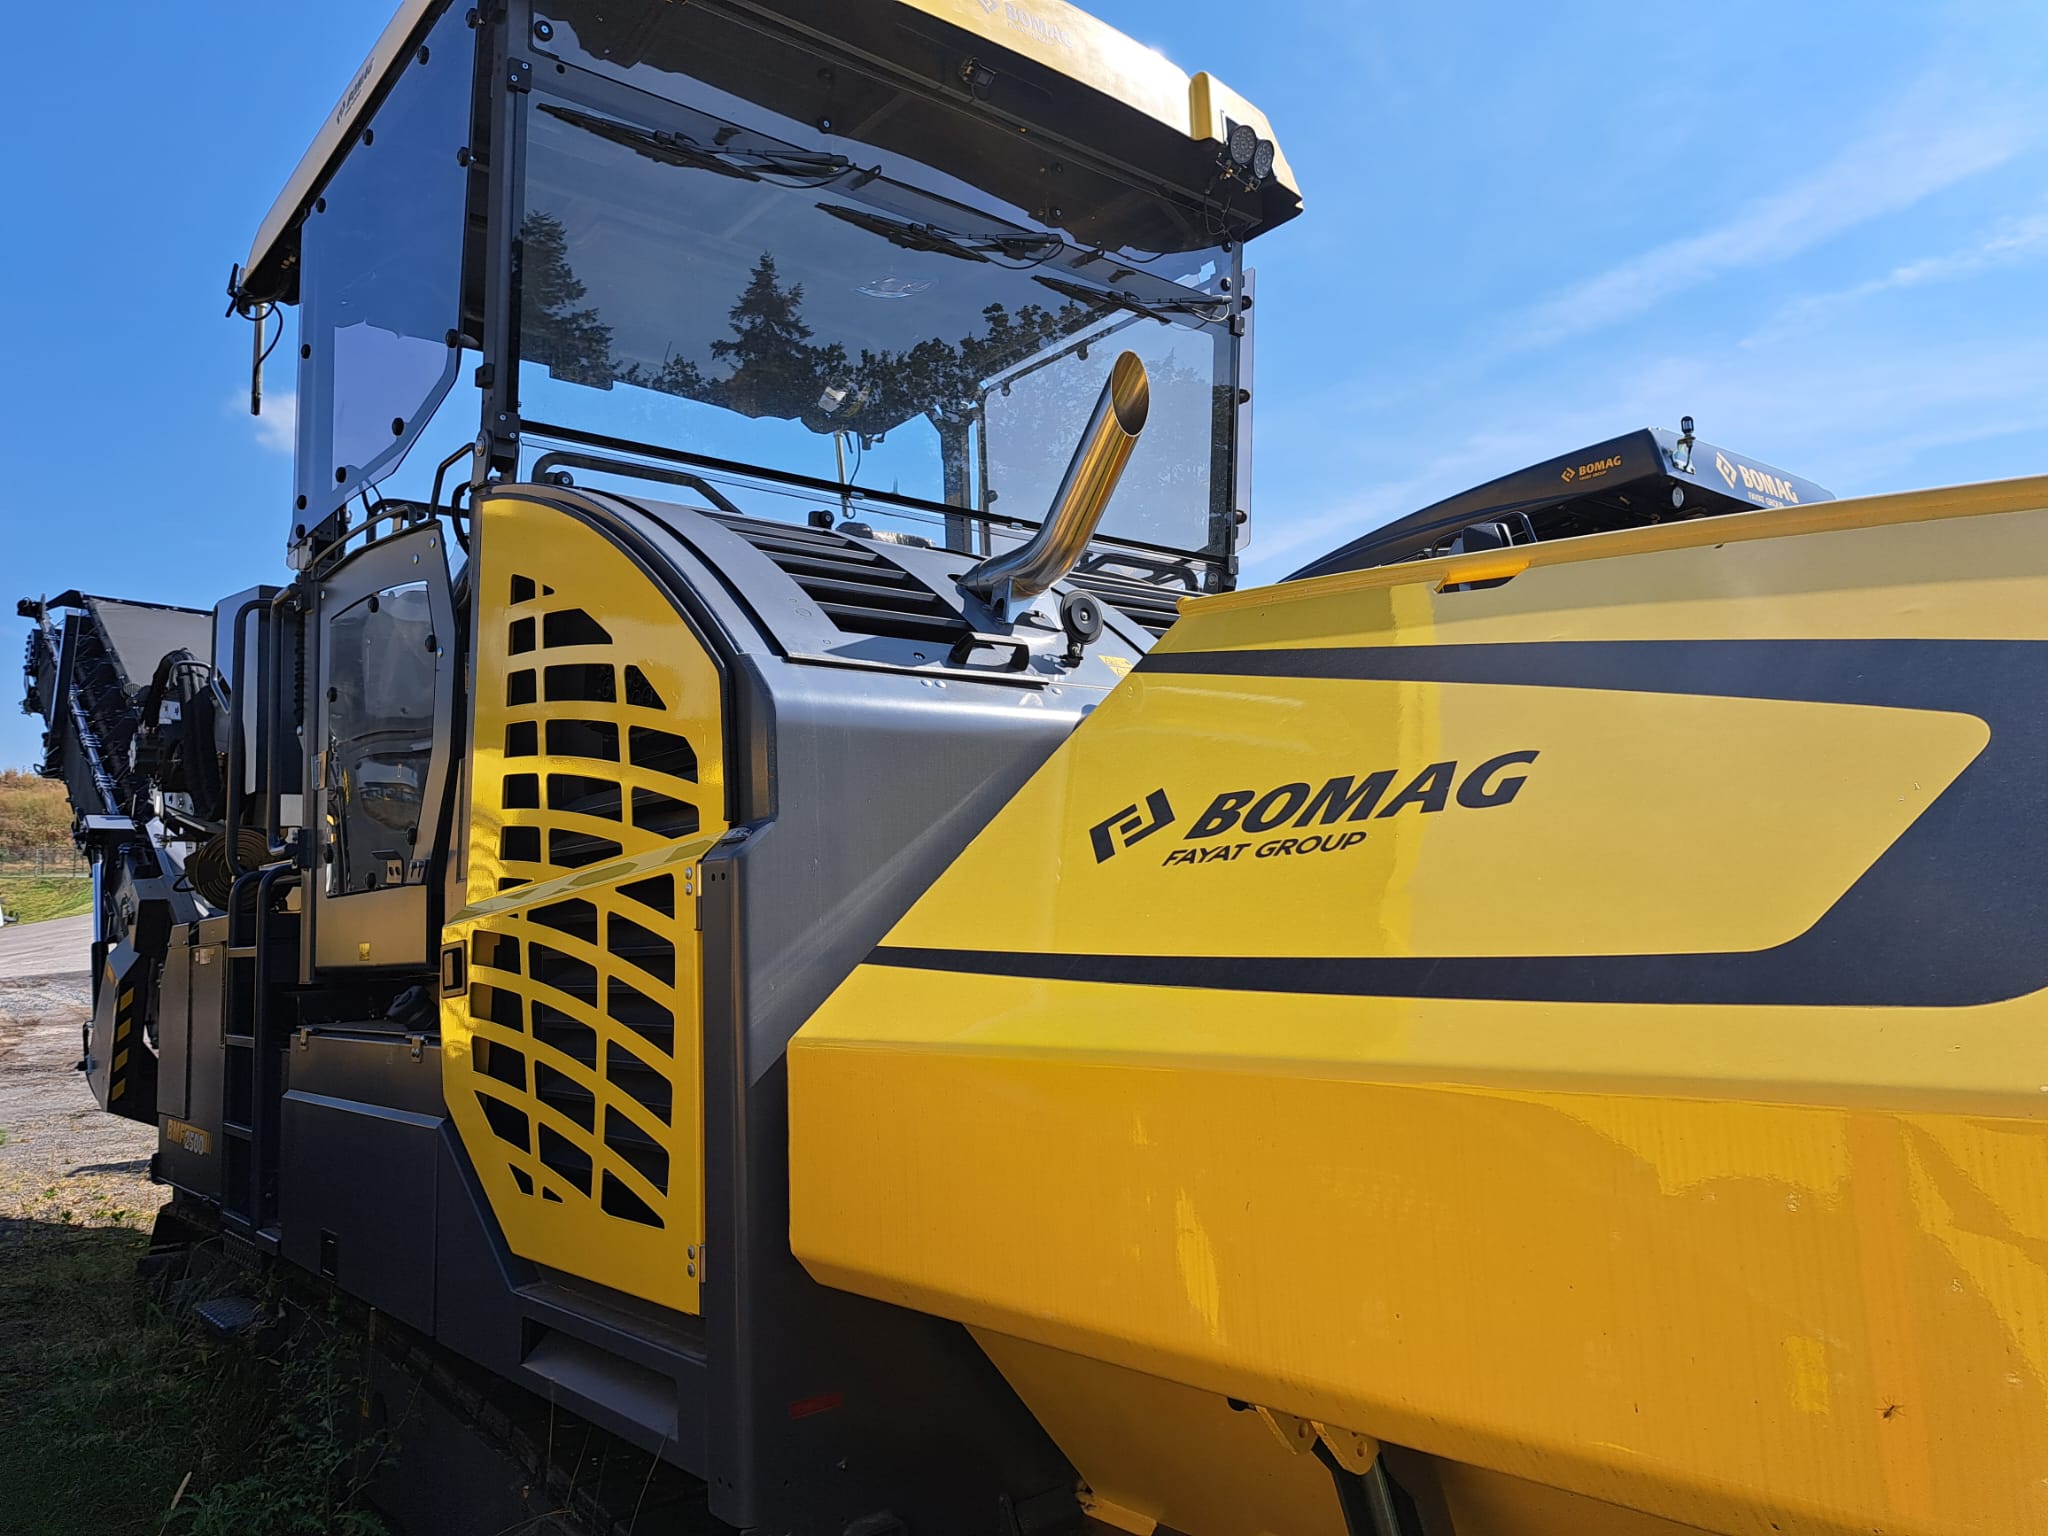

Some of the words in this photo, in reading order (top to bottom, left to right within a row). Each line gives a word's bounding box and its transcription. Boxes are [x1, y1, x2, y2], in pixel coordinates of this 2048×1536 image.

[1004, 2, 1072, 48] BOMAG
[1579, 455, 1622, 476] BOMAG
[1737, 464, 1800, 504] BOMAG
[1183, 750, 1540, 841] BOMAG
[1161, 843, 1252, 867] FAYAT
[1255, 831, 1367, 858] GROUP
